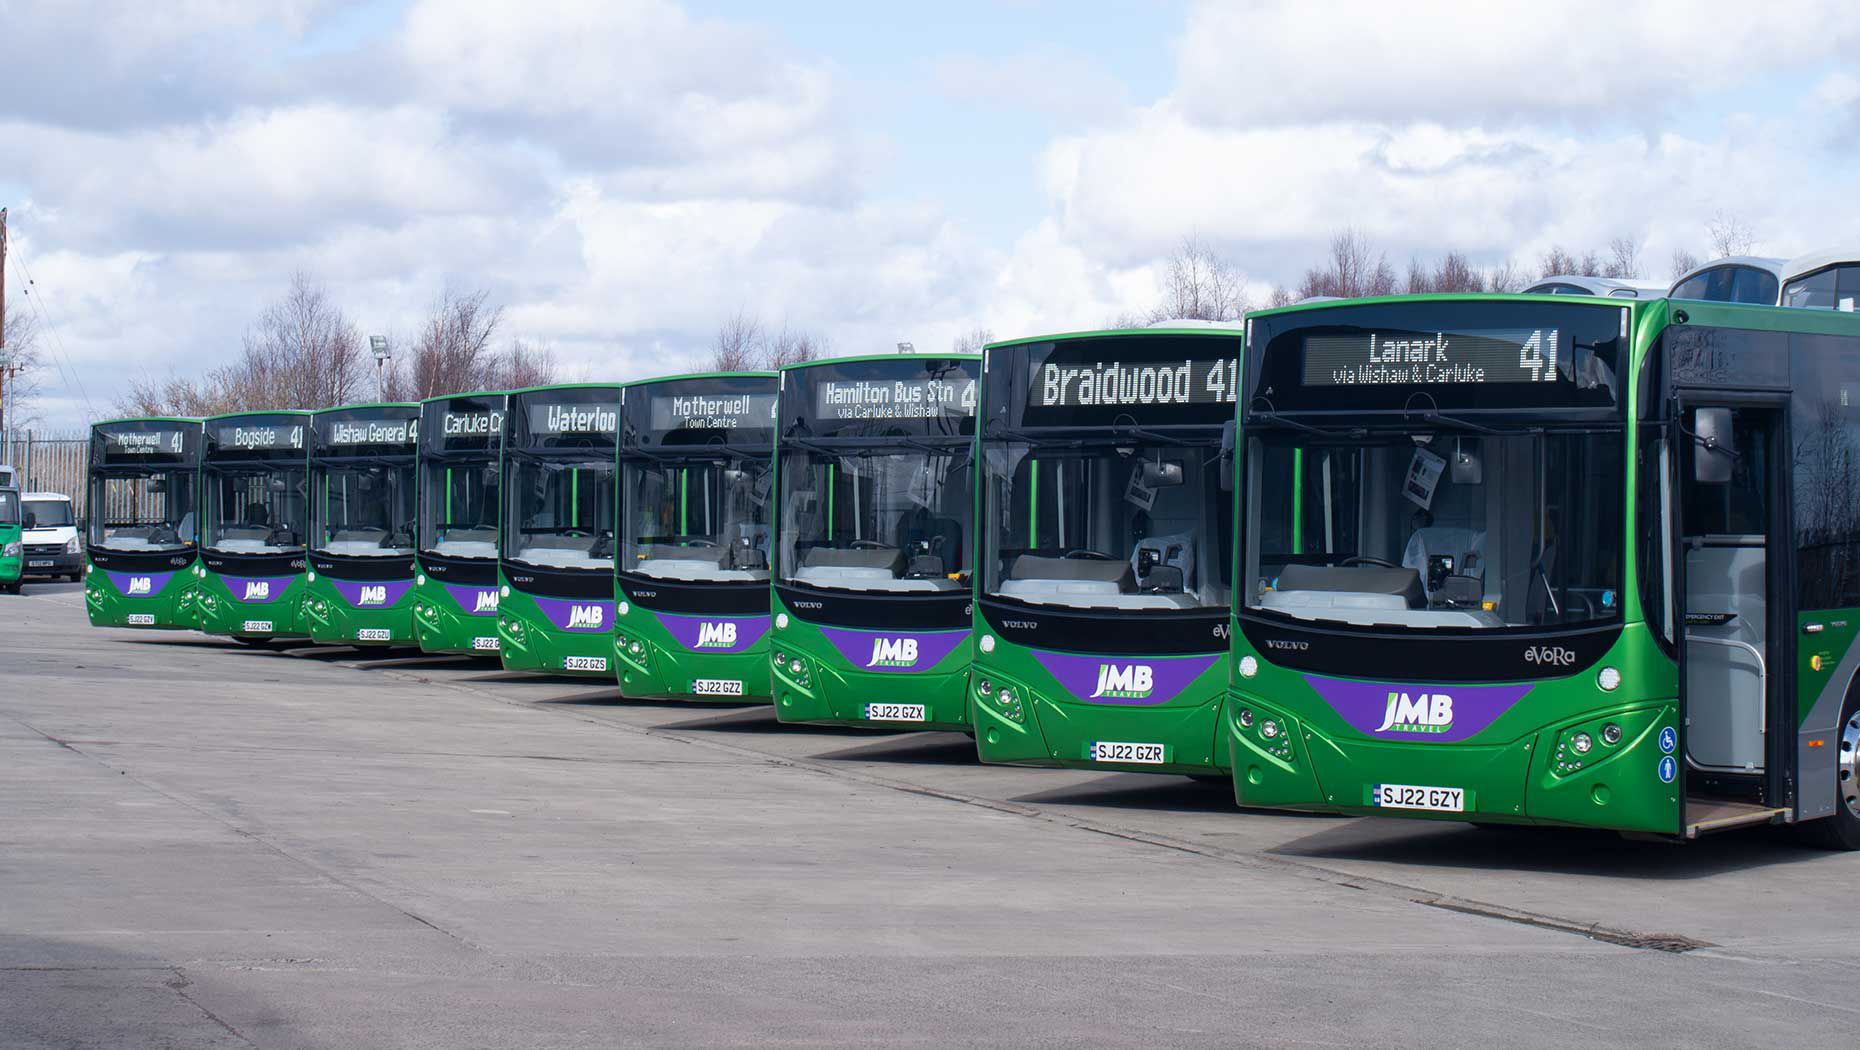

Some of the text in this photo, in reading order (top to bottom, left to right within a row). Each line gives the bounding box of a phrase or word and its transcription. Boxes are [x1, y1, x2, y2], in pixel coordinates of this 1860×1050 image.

[1369, 332, 1449, 363] Lanark
[1519, 330, 1559, 381] 41
[1043, 359, 1192, 406] Braidwood
[1206, 358, 1238, 402] 41
[1332, 363, 1485, 384] via Wishaw & Carluke
[825, 380, 953, 404] Hamilton Bus Stn
[673, 395, 750, 416] Motherwell
[837, 406, 853, 419] via
[854, 404, 893, 418] Carluke
[904, 403, 939, 418] Wishaw
[444, 413, 488, 434] Carluke
[548, 405, 616, 432] Waterloo
[684, 415, 737, 429] Town Centre
[118, 431, 162, 446] Motherwell
[171, 431, 184, 453] 41
[234, 427, 276, 449] Bogside
[289, 425, 304, 449] 41
[333, 421, 407, 443] Wishaw General
[127, 577, 152, 595] JMB
[243, 581, 270, 600] JMB
[357, 585, 387, 605] JMB
[632, 590, 657, 598] VOLVO
[794, 600, 823, 609] VOLVO
[565, 605, 604, 629] JMB
[1002, 619, 1038, 630] VOLVO
[360, 630, 376, 639] SJ22
[476, 638, 493, 648] SJ22
[693, 622, 737, 648] JMB
[1265, 639, 1309, 651] VOLVO
[866, 638, 919, 667] JMB
[1524, 645, 1576, 666] eVoRa
[568, 658, 605, 669] SJ22 GZS
[697, 681, 741, 694] SJ22 GZZ
[1089, 664, 1154, 698] JMB
[1105, 690, 1144, 699] TRAVEL
[871, 705, 923, 719] SJ22 GZX
[1374, 692, 1453, 732] JMB
[1395, 723, 1441, 734] TRAVEL
[1098, 744, 1162, 761] SJ22 GZR
[1383, 787, 1461, 808] SJ22 GZY
